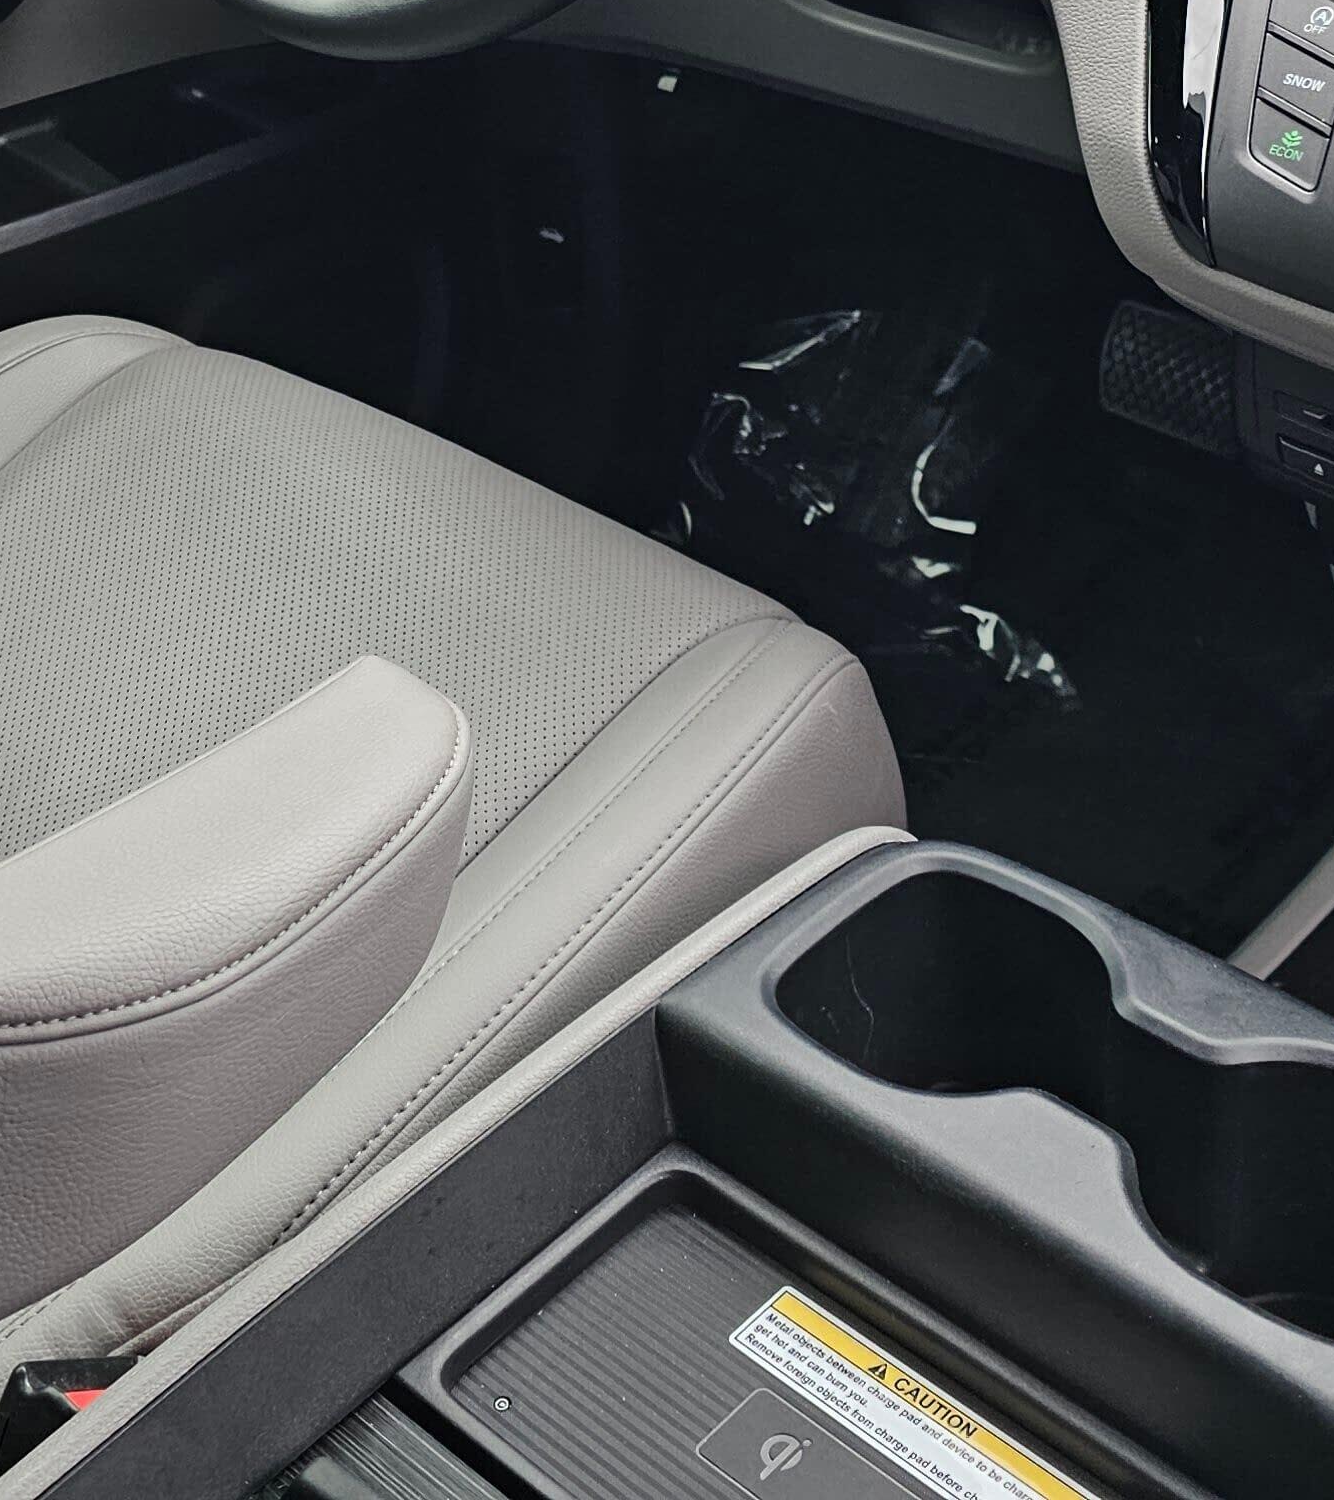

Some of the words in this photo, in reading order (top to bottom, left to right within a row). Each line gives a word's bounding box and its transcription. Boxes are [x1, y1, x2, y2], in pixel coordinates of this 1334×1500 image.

[1303, 23, 1328, 35] OFF
[1283, 73, 1326, 92] SNOW
[1269, 144, 1304, 162] ECON
[754, 1323, 772, 1338] get
[771, 1331, 788, 1350] hot
[788, 1345, 808, 1363] and
[807, 1361, 825, 1376] can
[825, 1370, 849, 1393] burn
[847, 1388, 869, 1408] you.
[744, 1333, 783, 1364] Remove
[783, 1360, 817, 1388] foreign
[816, 1384, 851, 1413] objects
[850, 1409, 874, 1429] from
[874, 1426, 909, 1454] charge
[907, 1450, 932, 1469] pad
[930, 1465, 964, 1492] before
[766, 1313, 795, 1336] Metal
[793, 1333, 826, 1359] objects
[826, 1355, 867, 1388] between
[867, 1384, 900, 1412] charge
[899, 1409, 923, 1426] pad
[921, 1424, 943, 1440] and
[942, 1437, 975, 1464] device
[975, 1460, 987, 1473] to
[988, 1468, 1003, 1483] be
[1003, 1481, 1033, 1500] char
[894, 1378, 978, 1438] CAUTION
